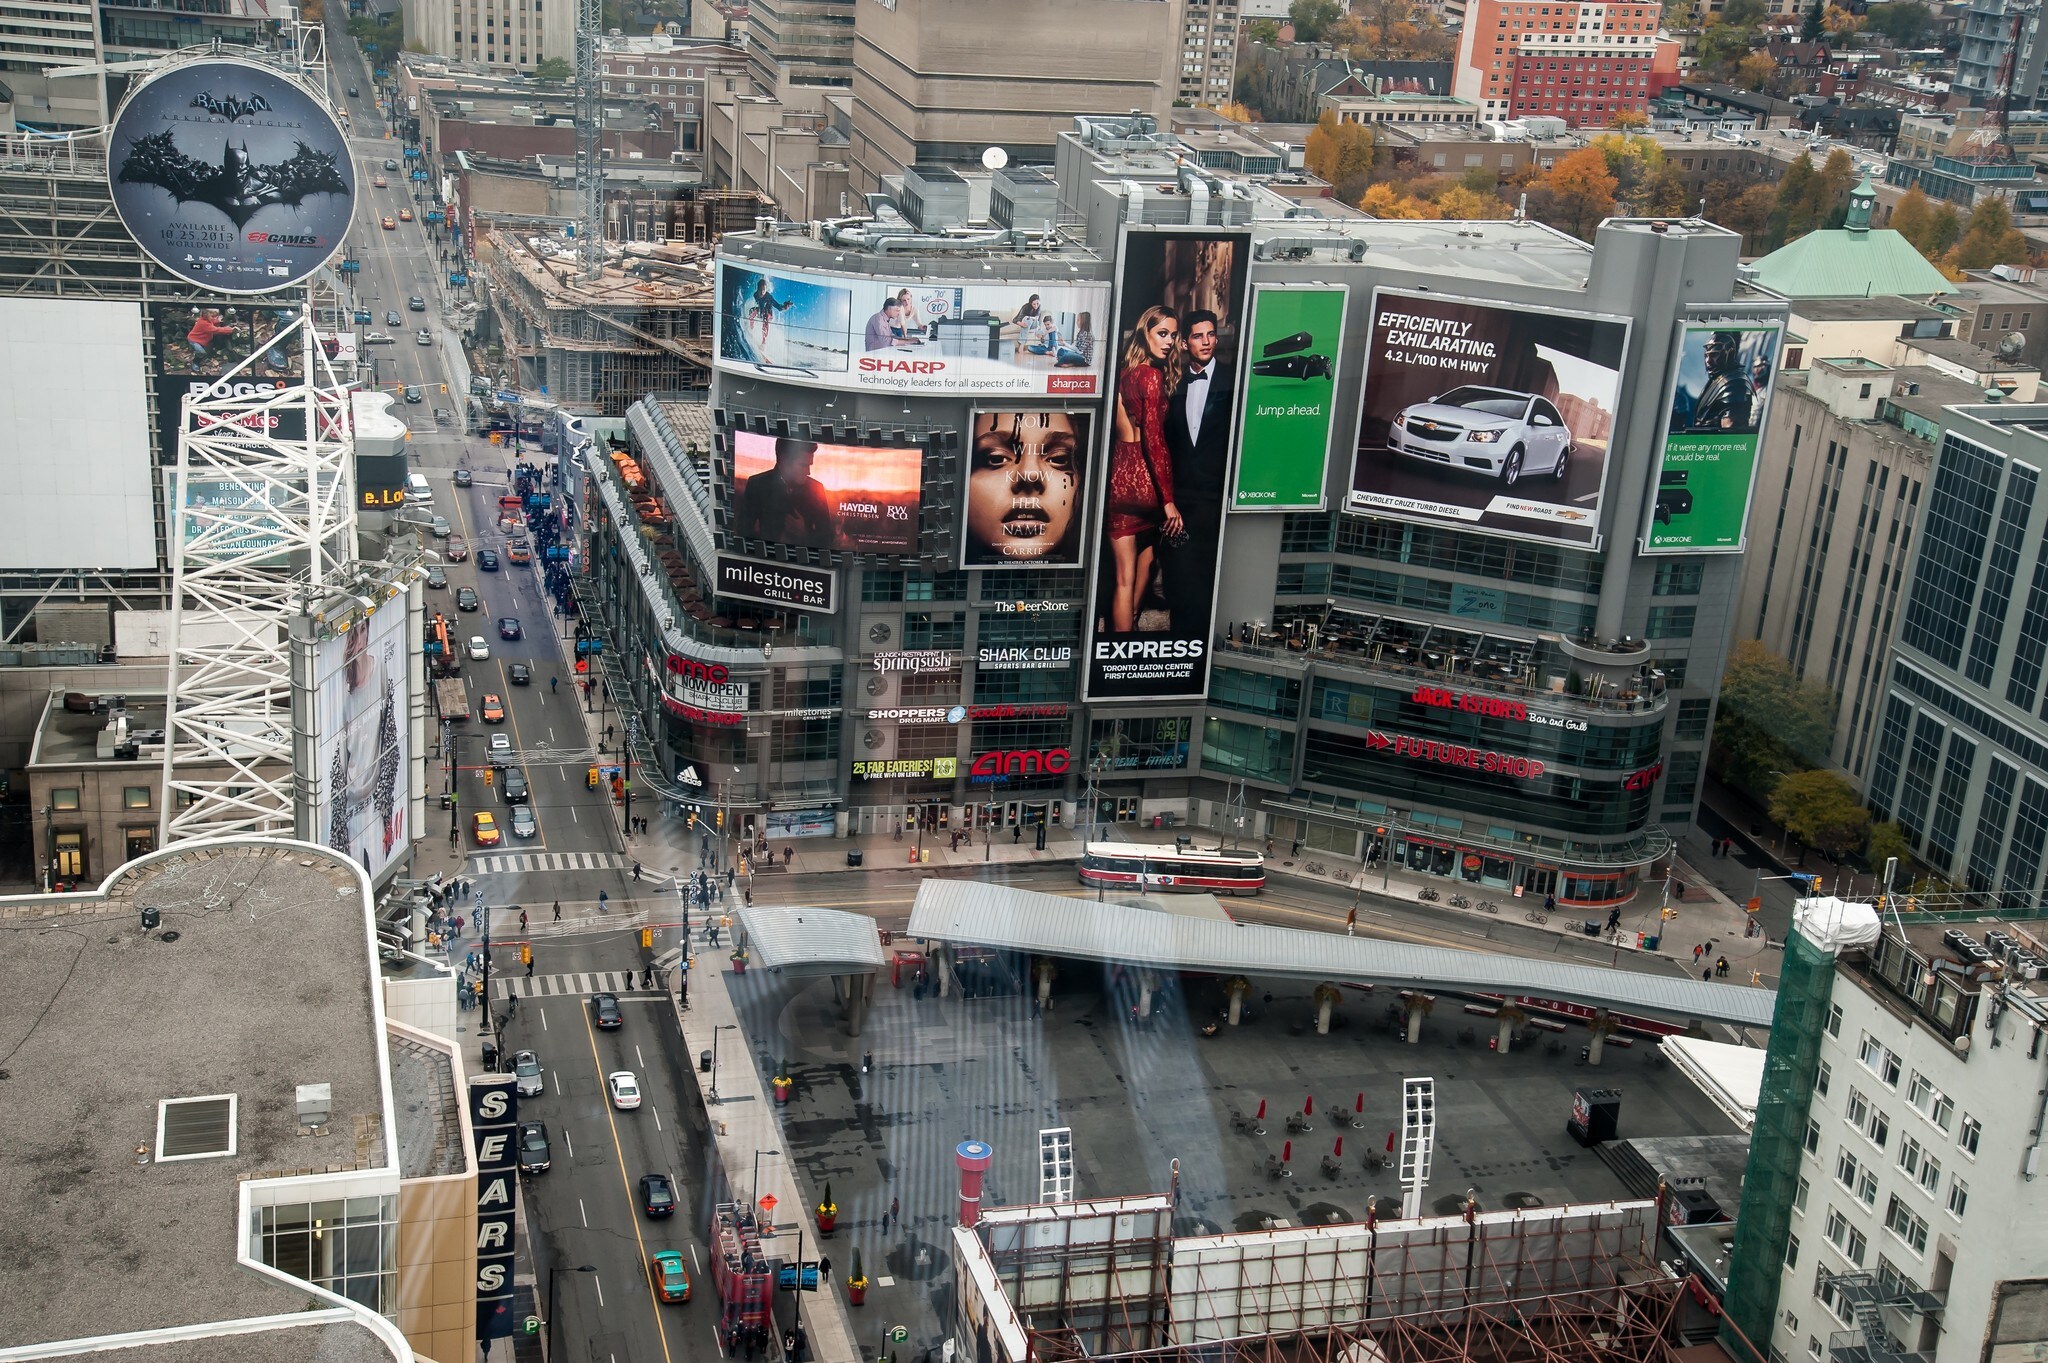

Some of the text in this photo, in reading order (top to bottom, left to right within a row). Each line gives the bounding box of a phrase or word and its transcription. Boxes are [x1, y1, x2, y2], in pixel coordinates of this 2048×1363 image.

[197, 93, 268, 120] BATMAN
[161, 113, 302, 128] ARKHAM ORIGINS
[168, 222, 227, 232] AVAILABLE
[160, 229, 234, 243] 10.25.2013
[166, 239, 231, 250] WORLDWIDE
[1378, 312, 1472, 337] EFFICIENTLY
[1386, 330, 1497, 358] EXHILARATING.
[858, 357, 946, 374] SHARP
[1384, 350, 1489, 374] 4.2 L/100 KM HWY
[858, 373, 1031, 391] Technology leaders for all aspects of life.
[1051, 379, 1091, 391] sharp.ca
[189, 382, 276, 399] BOGS
[1256, 404, 1321, 418] Jump ahead.
[1016, 415, 1047, 428] YOU
[1012, 443, 1048, 456] WILL
[1667, 443, 1673, 451] If
[1673, 443, 1679, 451] it
[1697, 444, 1712, 453] any
[1733, 442, 1747, 452] real,
[1665, 453, 1720, 461] it would be real.
[1005, 470, 1054, 483] KNOW
[583, 476, 591, 530] FUTURE
[839, 502, 878, 514] HAYDEN
[1011, 496, 1042, 509] HER
[1356, 493, 1461, 516] CHEVROLET CRUZE TURBO DIESEL
[1520, 504, 1534, 512] NEW
[1533, 507, 1552, 515] ROADS
[837, 511, 880, 519] CHRISTENSEN
[1001, 523, 1046, 536] NAME
[582, 538, 590, 573] SHOP
[725, 565, 824, 594] milestones
[764, 588, 823, 605] GRILL BAR
[994, 600, 1015, 612] The
[1041, 600, 1069, 612] Store
[979, 647, 1071, 662] SHARK CLUB
[1095, 640, 1204, 660] EXPRESS
[873, 651, 951, 675] spring sushi
[1102, 664, 1138, 672] TORONTO
[1164, 662, 1194, 670] CENTRE
[1104, 670, 1190, 680] FIRST CANADIAN PLACE
[682, 675, 743, 696] NOW OPEN
[688, 692, 743, 705] SHARK CLUB
[1412, 685, 1527, 722] JACK ASTOR'S
[706, 710, 743, 725] SHOP
[784, 707, 832, 718] milestones
[868, 708, 946, 719] SHOPPERS
[1018, 704, 1067, 716] FITNESS
[922, 716, 945, 724] MART
[1157, 719, 1190, 731] NOW
[1528, 712, 1588, 732] Bar and Grill
[1145, 754, 1184, 766] FITNESS
[1394, 734, 1545, 780] FUTURE SHOP
[853, 759, 933, 774] 25 FAB EATERIES!
[677, 774, 702, 787] adidas
[971, 774, 1010, 783] IMAX
[477, 1091, 508, 1292] SEARS
[526, 1322, 538, 1332] P
[895, 1330, 907, 1341] P
